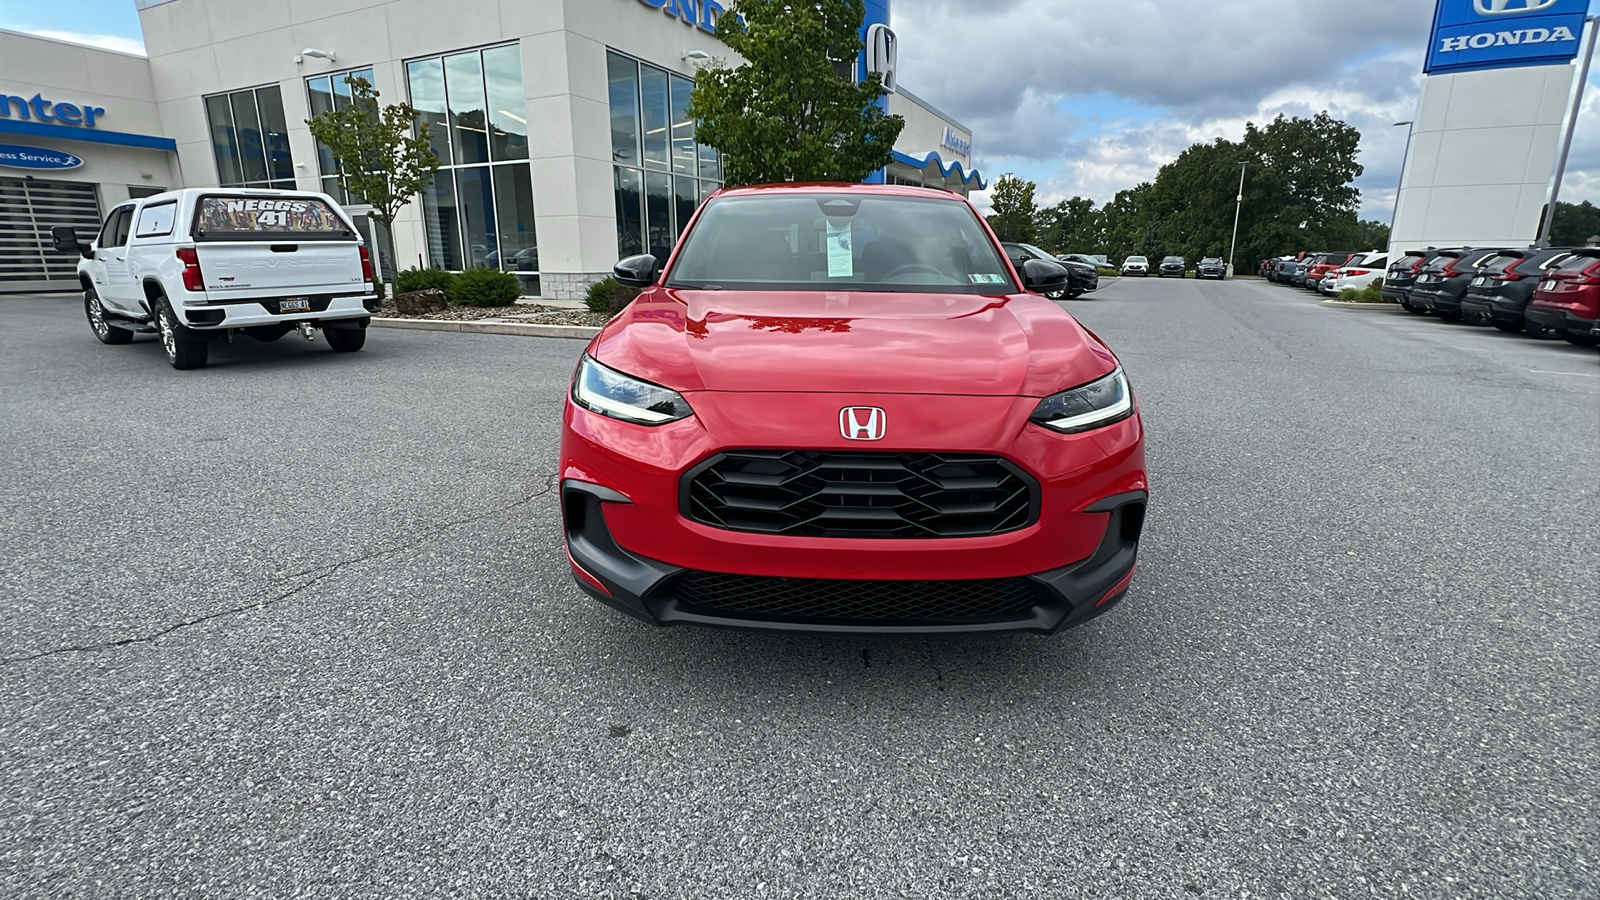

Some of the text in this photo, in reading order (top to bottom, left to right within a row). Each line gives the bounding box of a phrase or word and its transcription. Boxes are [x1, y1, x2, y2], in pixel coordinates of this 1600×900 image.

[1439, 26, 1576, 53] HONDA
[0, 93, 105, 127] nter
[19, 152, 61, 163] Service
[227, 200, 308, 213] NEGGS
[257, 210, 287, 226] 41
